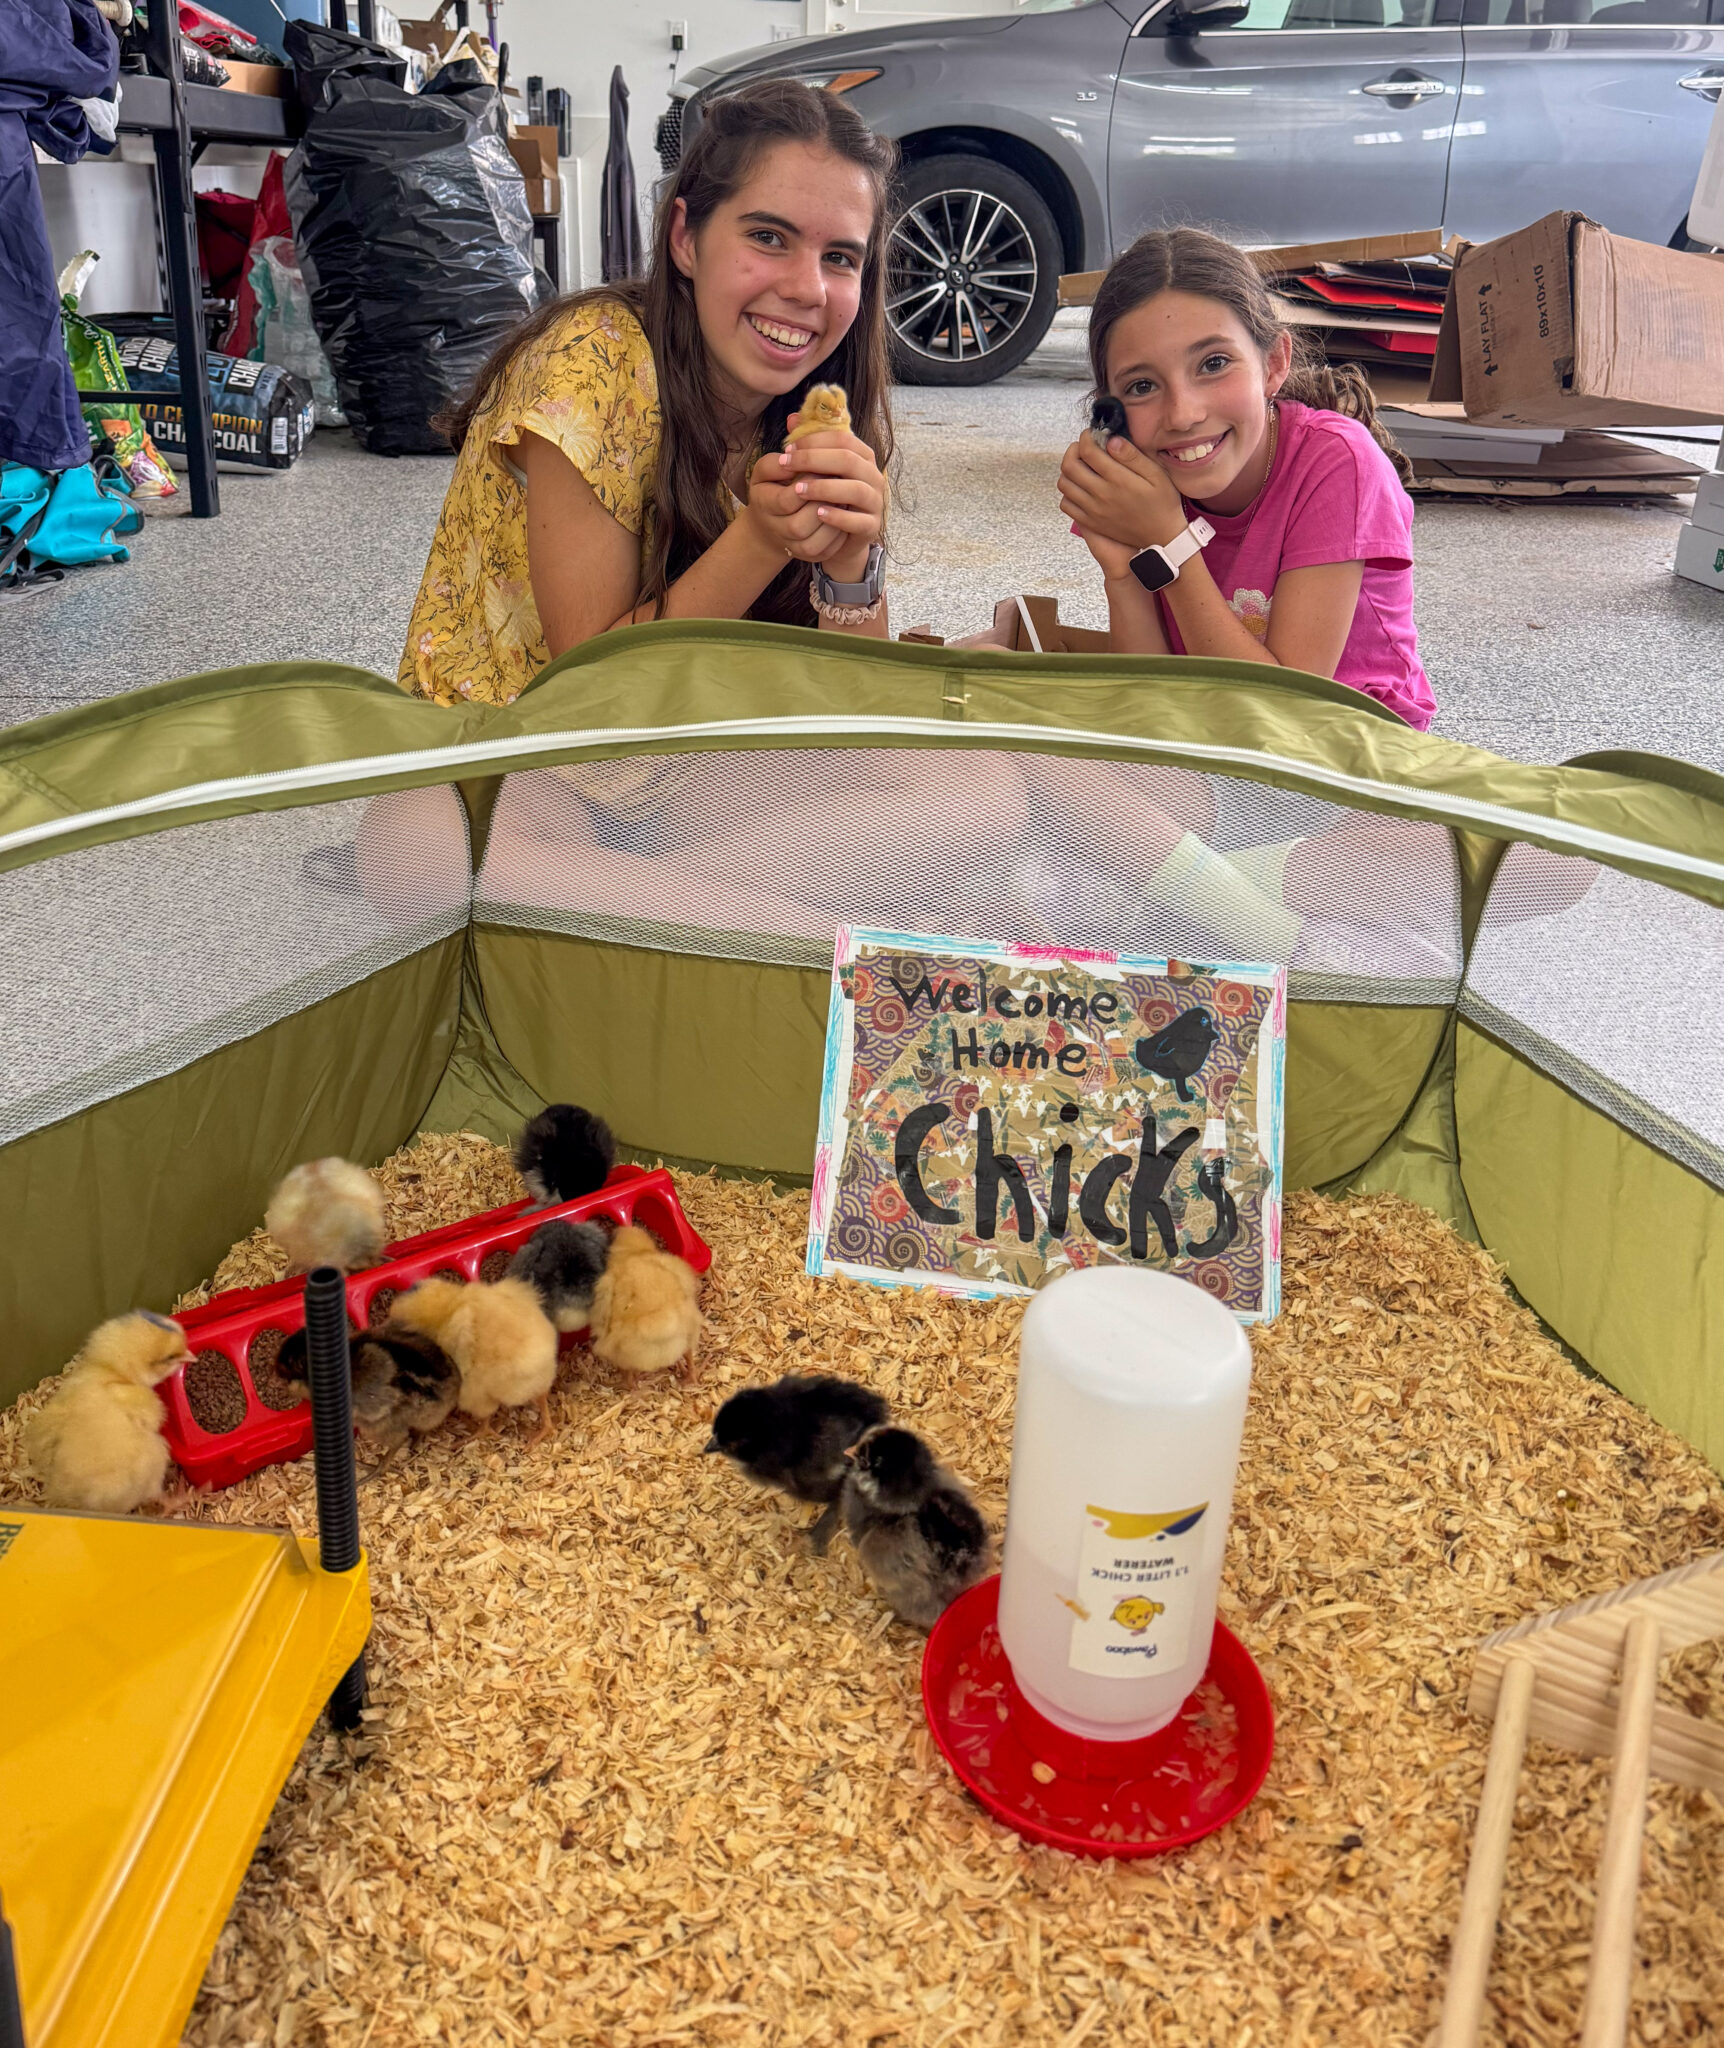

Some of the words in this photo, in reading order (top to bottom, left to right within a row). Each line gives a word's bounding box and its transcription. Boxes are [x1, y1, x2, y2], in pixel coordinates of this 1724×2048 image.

[1533, 264, 1550, 338] 89x10x10
[1479, 301, 1489, 334] FLAT
[1482, 339, 1491, 364] LAY
[164, 405, 263, 434] CHPION
[153, 421, 262, 454] CHCOAL
[889, 969, 1119, 1025] Welcome
[951, 1028, 1088, 1077] Home
[1091, 1567, 1132, 1582] CHICK
[1114, 1556, 1175, 1569] WATERER
[1136, 1570, 1171, 1582] LITER
